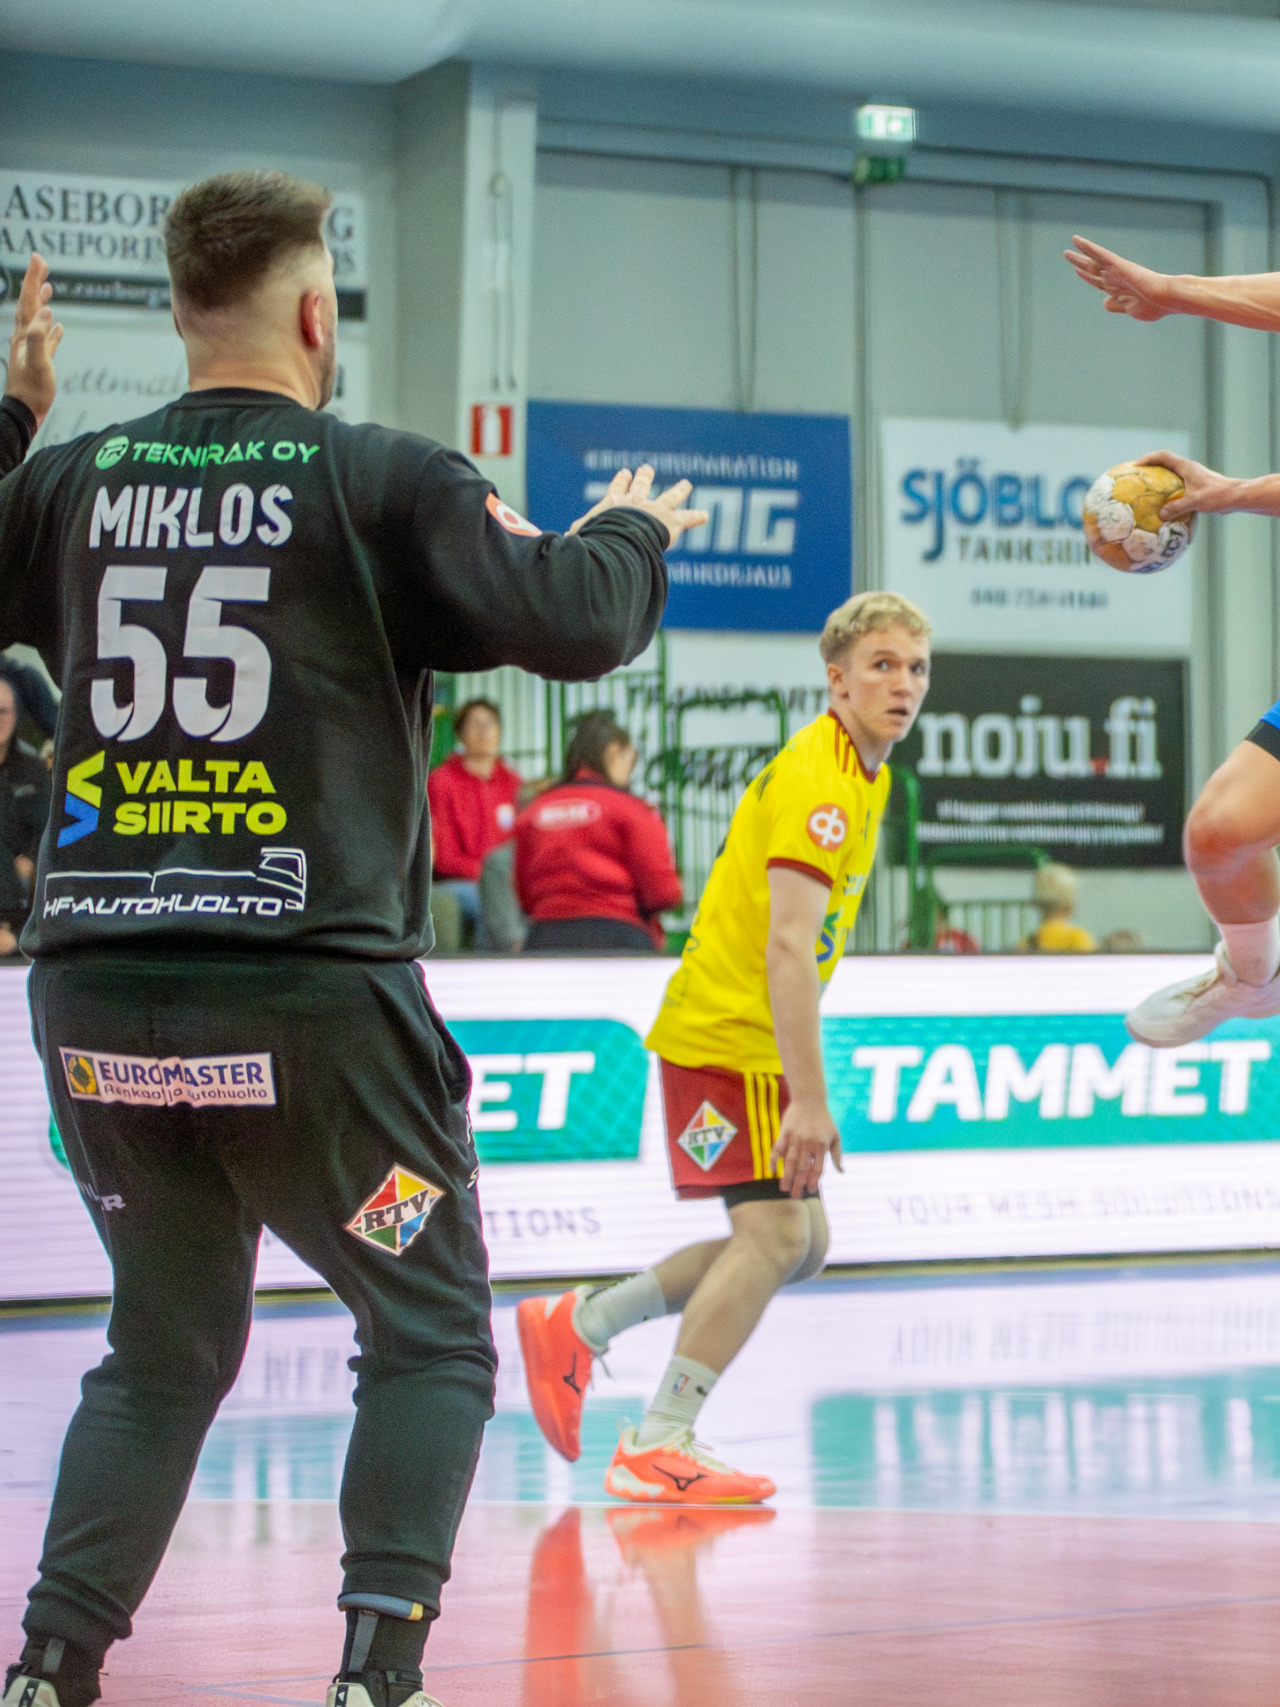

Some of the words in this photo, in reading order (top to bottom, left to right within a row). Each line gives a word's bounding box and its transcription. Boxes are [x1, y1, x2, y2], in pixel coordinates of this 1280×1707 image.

[3, 183, 171, 228] ASEBOR
[131, 440, 266, 468] TEKNIRAK
[271, 440, 321, 463] OY
[88, 482, 294, 549] MIKLOS
[901, 457, 1092, 563] SJÖBLO
[89, 564, 273, 744] 55
[915, 693, 1163, 780] noju.fi
[115, 760, 277, 795] VALTA
[112, 801, 288, 836] SIIRTO
[98, 1059, 265, 1088] EUROMASTER
[851, 1038, 1273, 1124] TAMMET
[687, 1126, 726, 1146] RTV
[363, 1189, 430, 1234] RTV
[485, 1207, 602, 1238] TIONS
